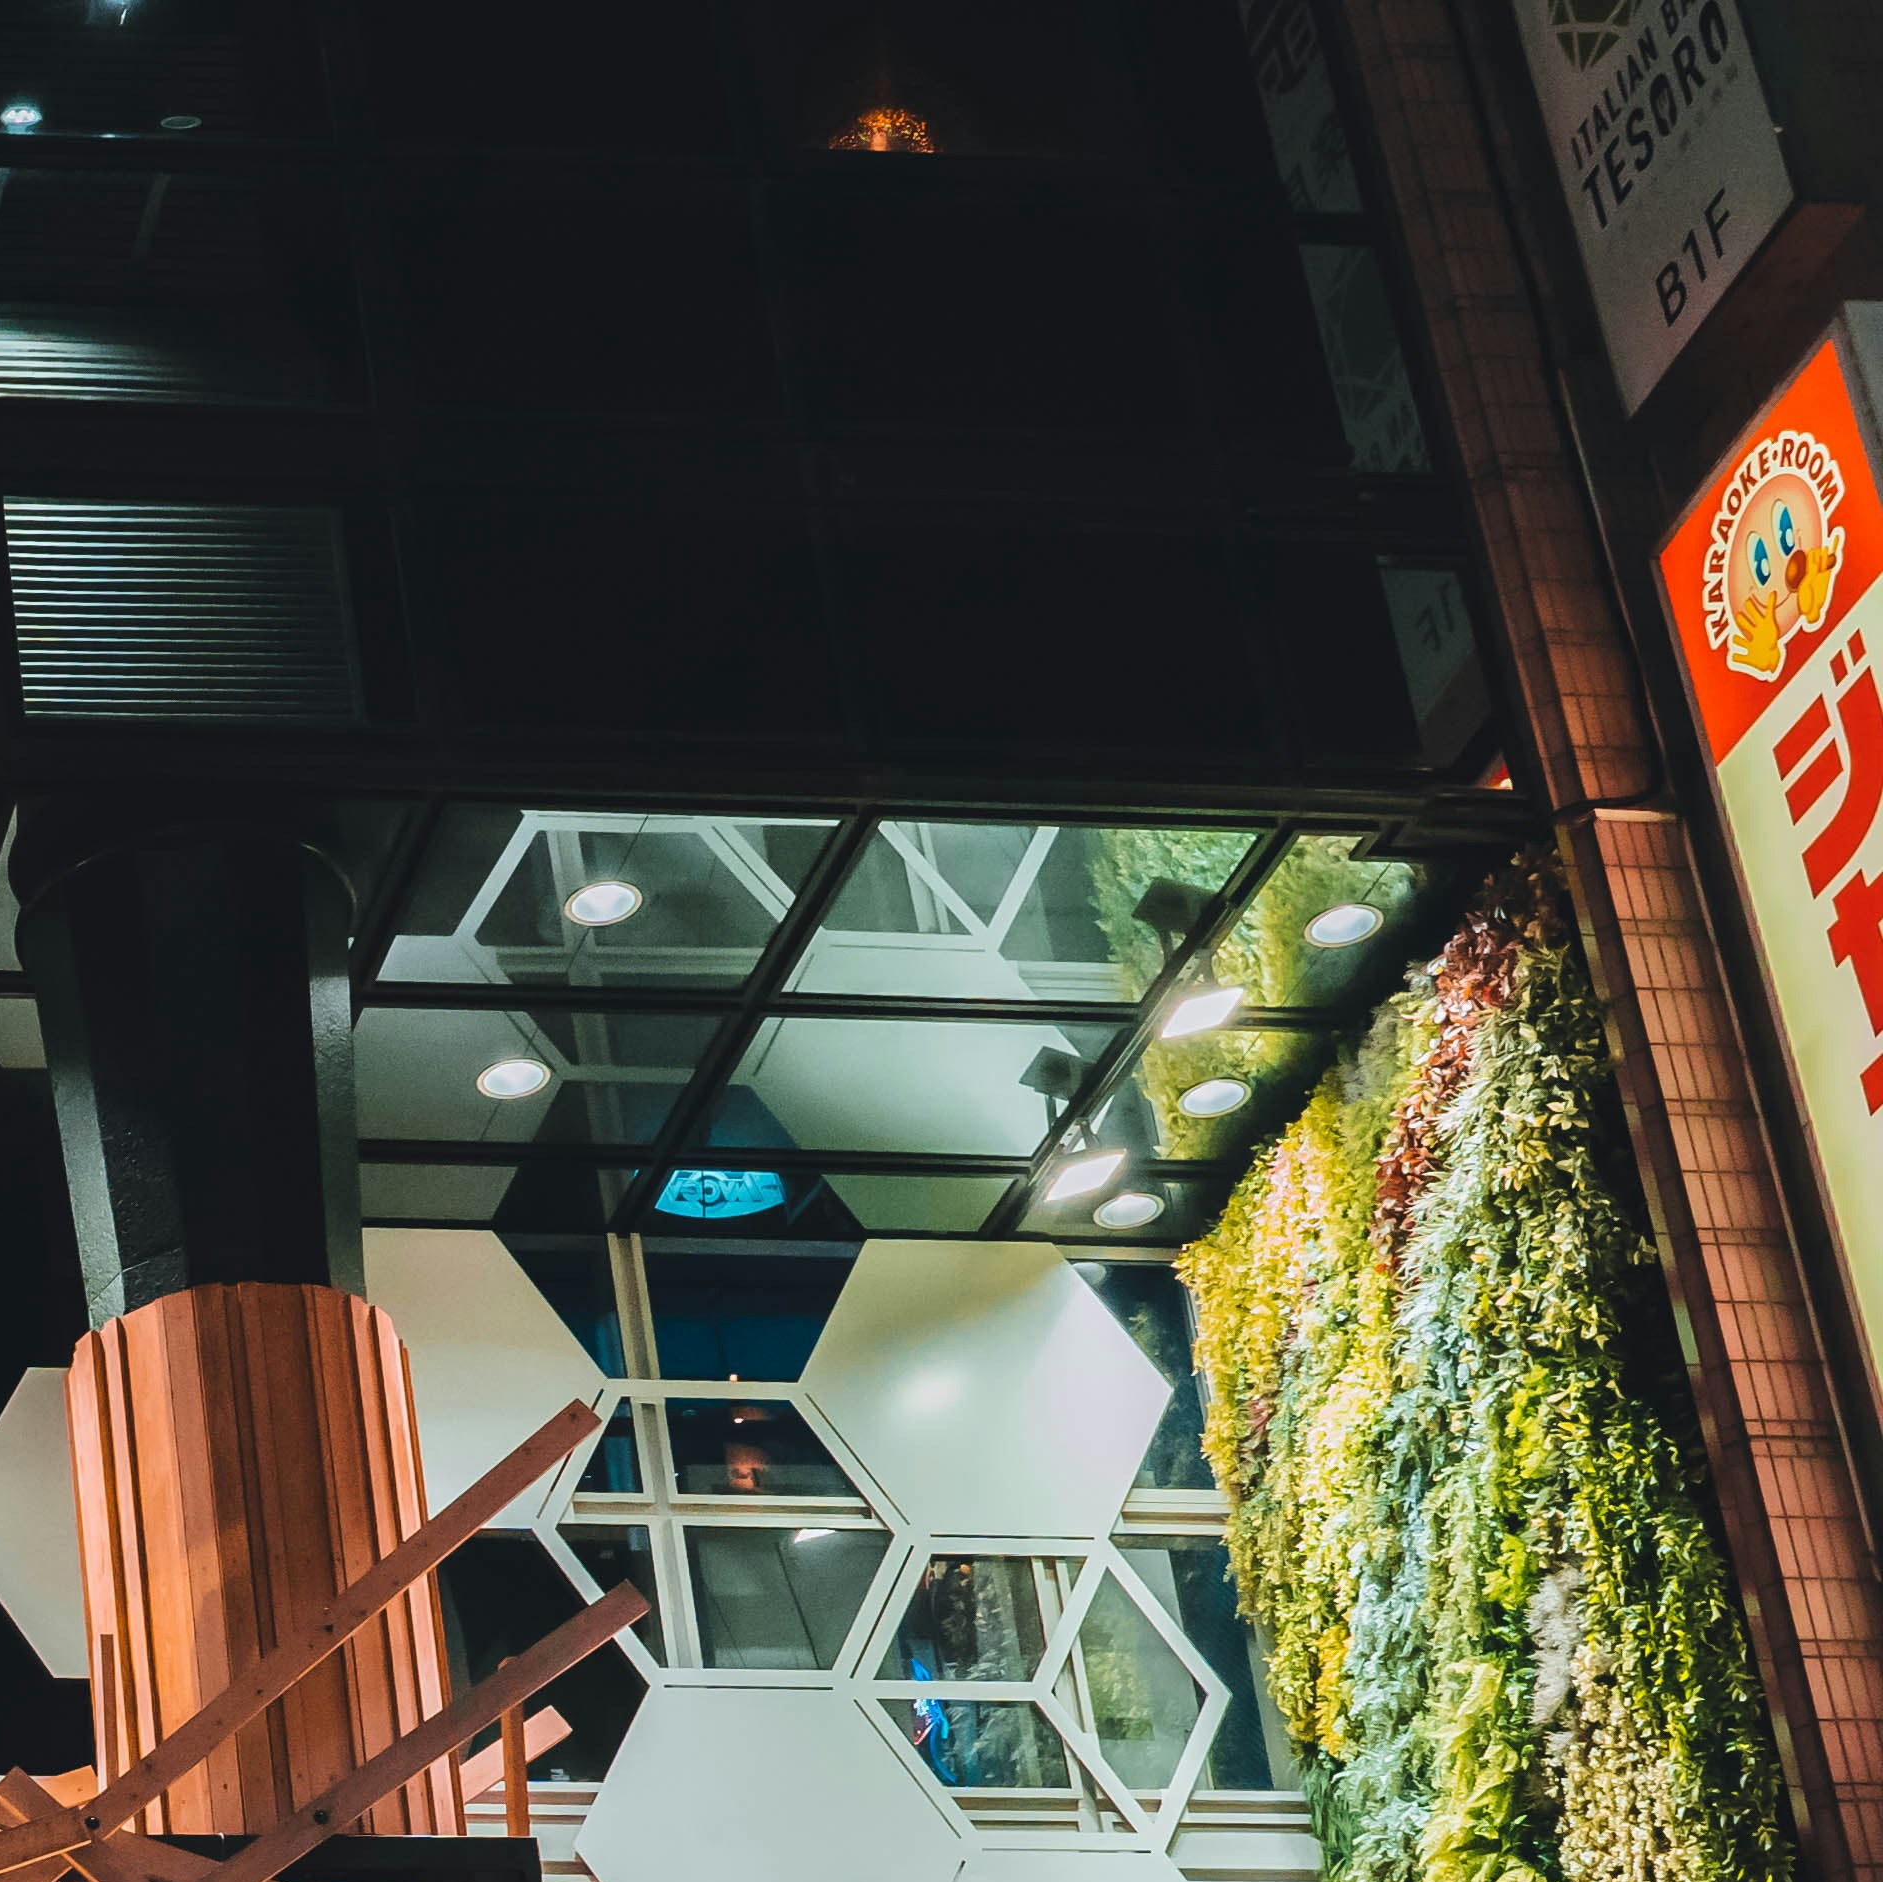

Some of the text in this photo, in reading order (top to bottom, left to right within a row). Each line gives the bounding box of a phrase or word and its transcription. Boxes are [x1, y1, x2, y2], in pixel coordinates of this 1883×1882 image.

[1570, 26, 1660, 170] ITALIAN
[1582, 0, 1729, 229] TESORO
[1655, 188, 1731, 327] B1F
